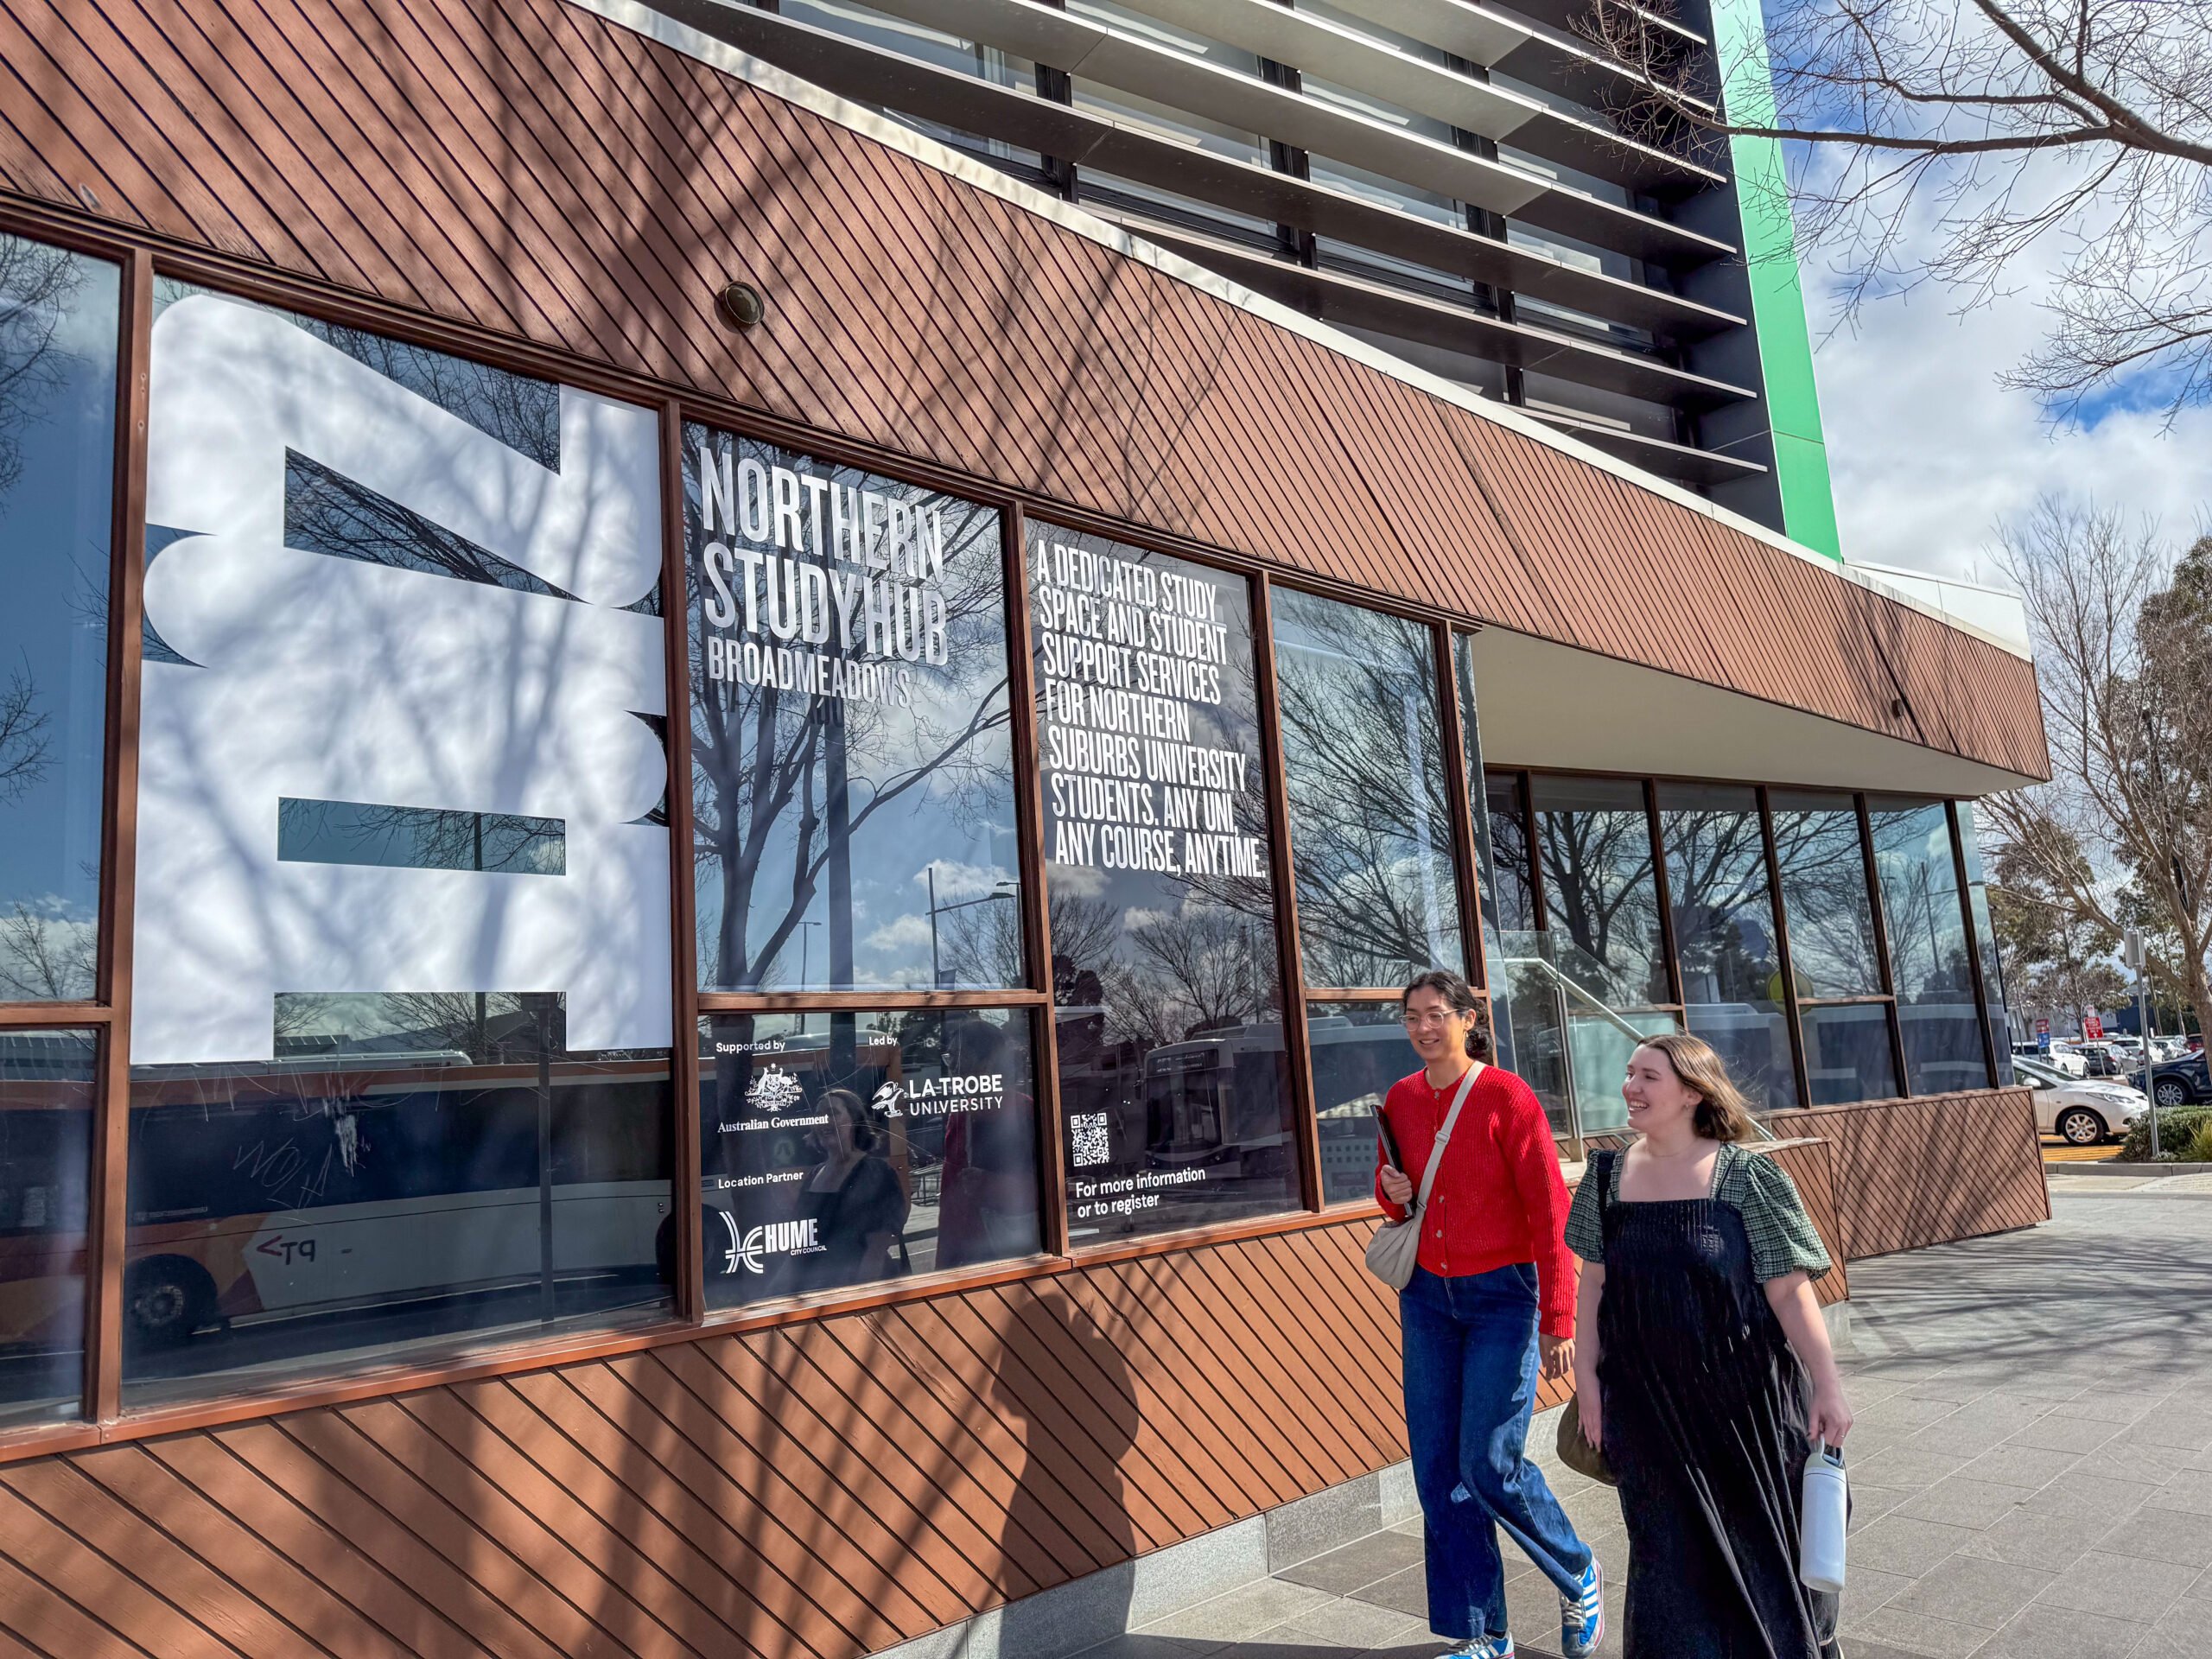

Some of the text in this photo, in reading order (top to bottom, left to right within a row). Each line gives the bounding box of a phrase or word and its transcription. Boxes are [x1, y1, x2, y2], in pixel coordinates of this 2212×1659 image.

[700, 447, 944, 584] NORTHERN
[1038, 539, 1217, 622] A DEDICATED STUDY
[703, 542, 948, 666] STUDY HUB
[1039, 585, 1227, 665] SPACE AND STUDENT
[708, 636, 910, 709] BROADMEADOWS
[1042, 632, 1221, 706] SUPPORT SERVICES
[1045, 677, 1192, 743] FOR NORTHERN
[1048, 726, 1246, 792] SUBURBS UNIVERSITY
[1051, 772, 1238, 836] STUDENTS. ANY UNI,
[1055, 821, 1267, 879] ANY COURSE, ANYTIME.
[715, 1039, 786, 1054] Supported by
[868, 1035, 898, 1047] Led by
[909, 1074, 1003, 1098] LA TROBE
[910, 1096, 1003, 1116] UNIVERSITY
[717, 1114, 830, 1133] Australian Government
[718, 1171, 804, 1189] Location Partner
[1076, 1166, 1206, 1198] For more information
[1077, 1193, 1160, 1218] or to register
[766, 1218, 818, 1253] HUME
[803, 1245, 827, 1254] COUNCIL
